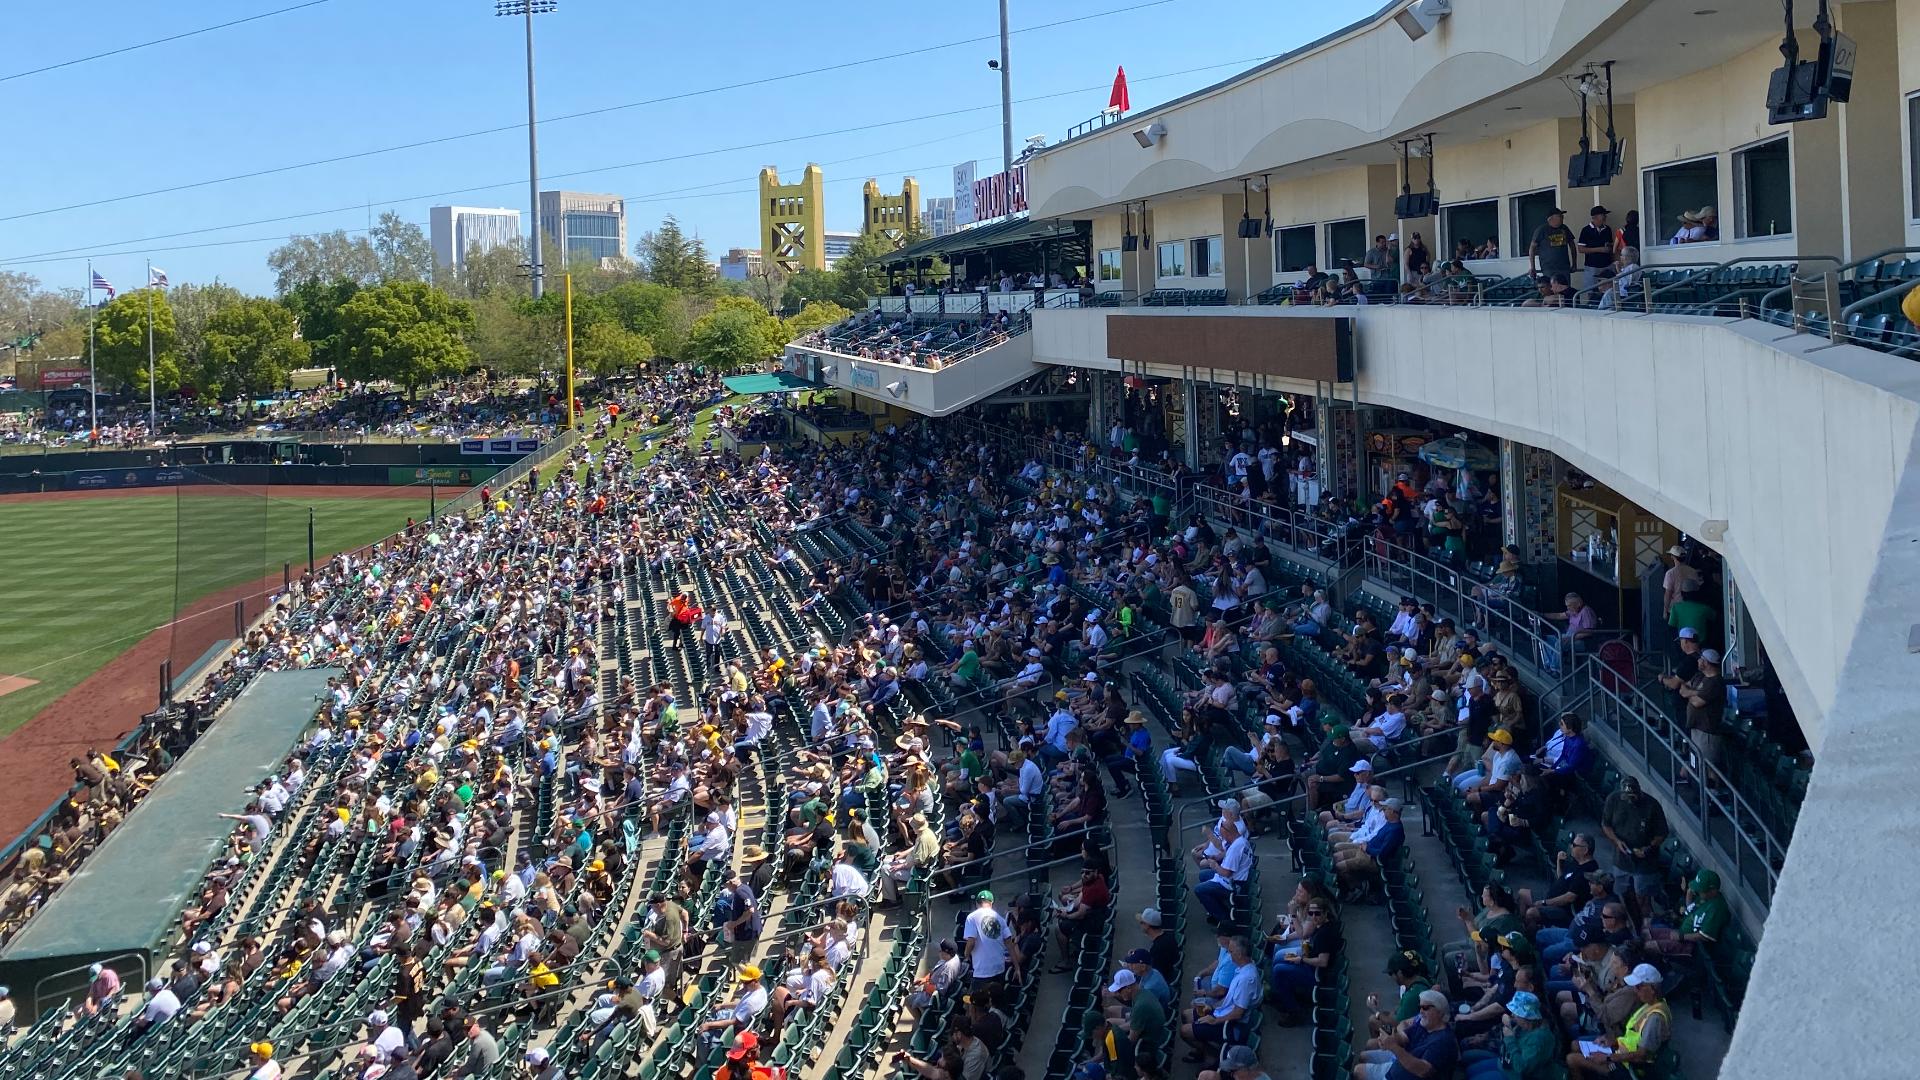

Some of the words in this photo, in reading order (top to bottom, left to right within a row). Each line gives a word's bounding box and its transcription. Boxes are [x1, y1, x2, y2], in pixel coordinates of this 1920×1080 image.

[957, 169, 967, 187] SKY
[955, 192, 970, 210] RIVER
[973, 171, 1008, 221] SOLON
[1010, 166, 1028, 212] CL
